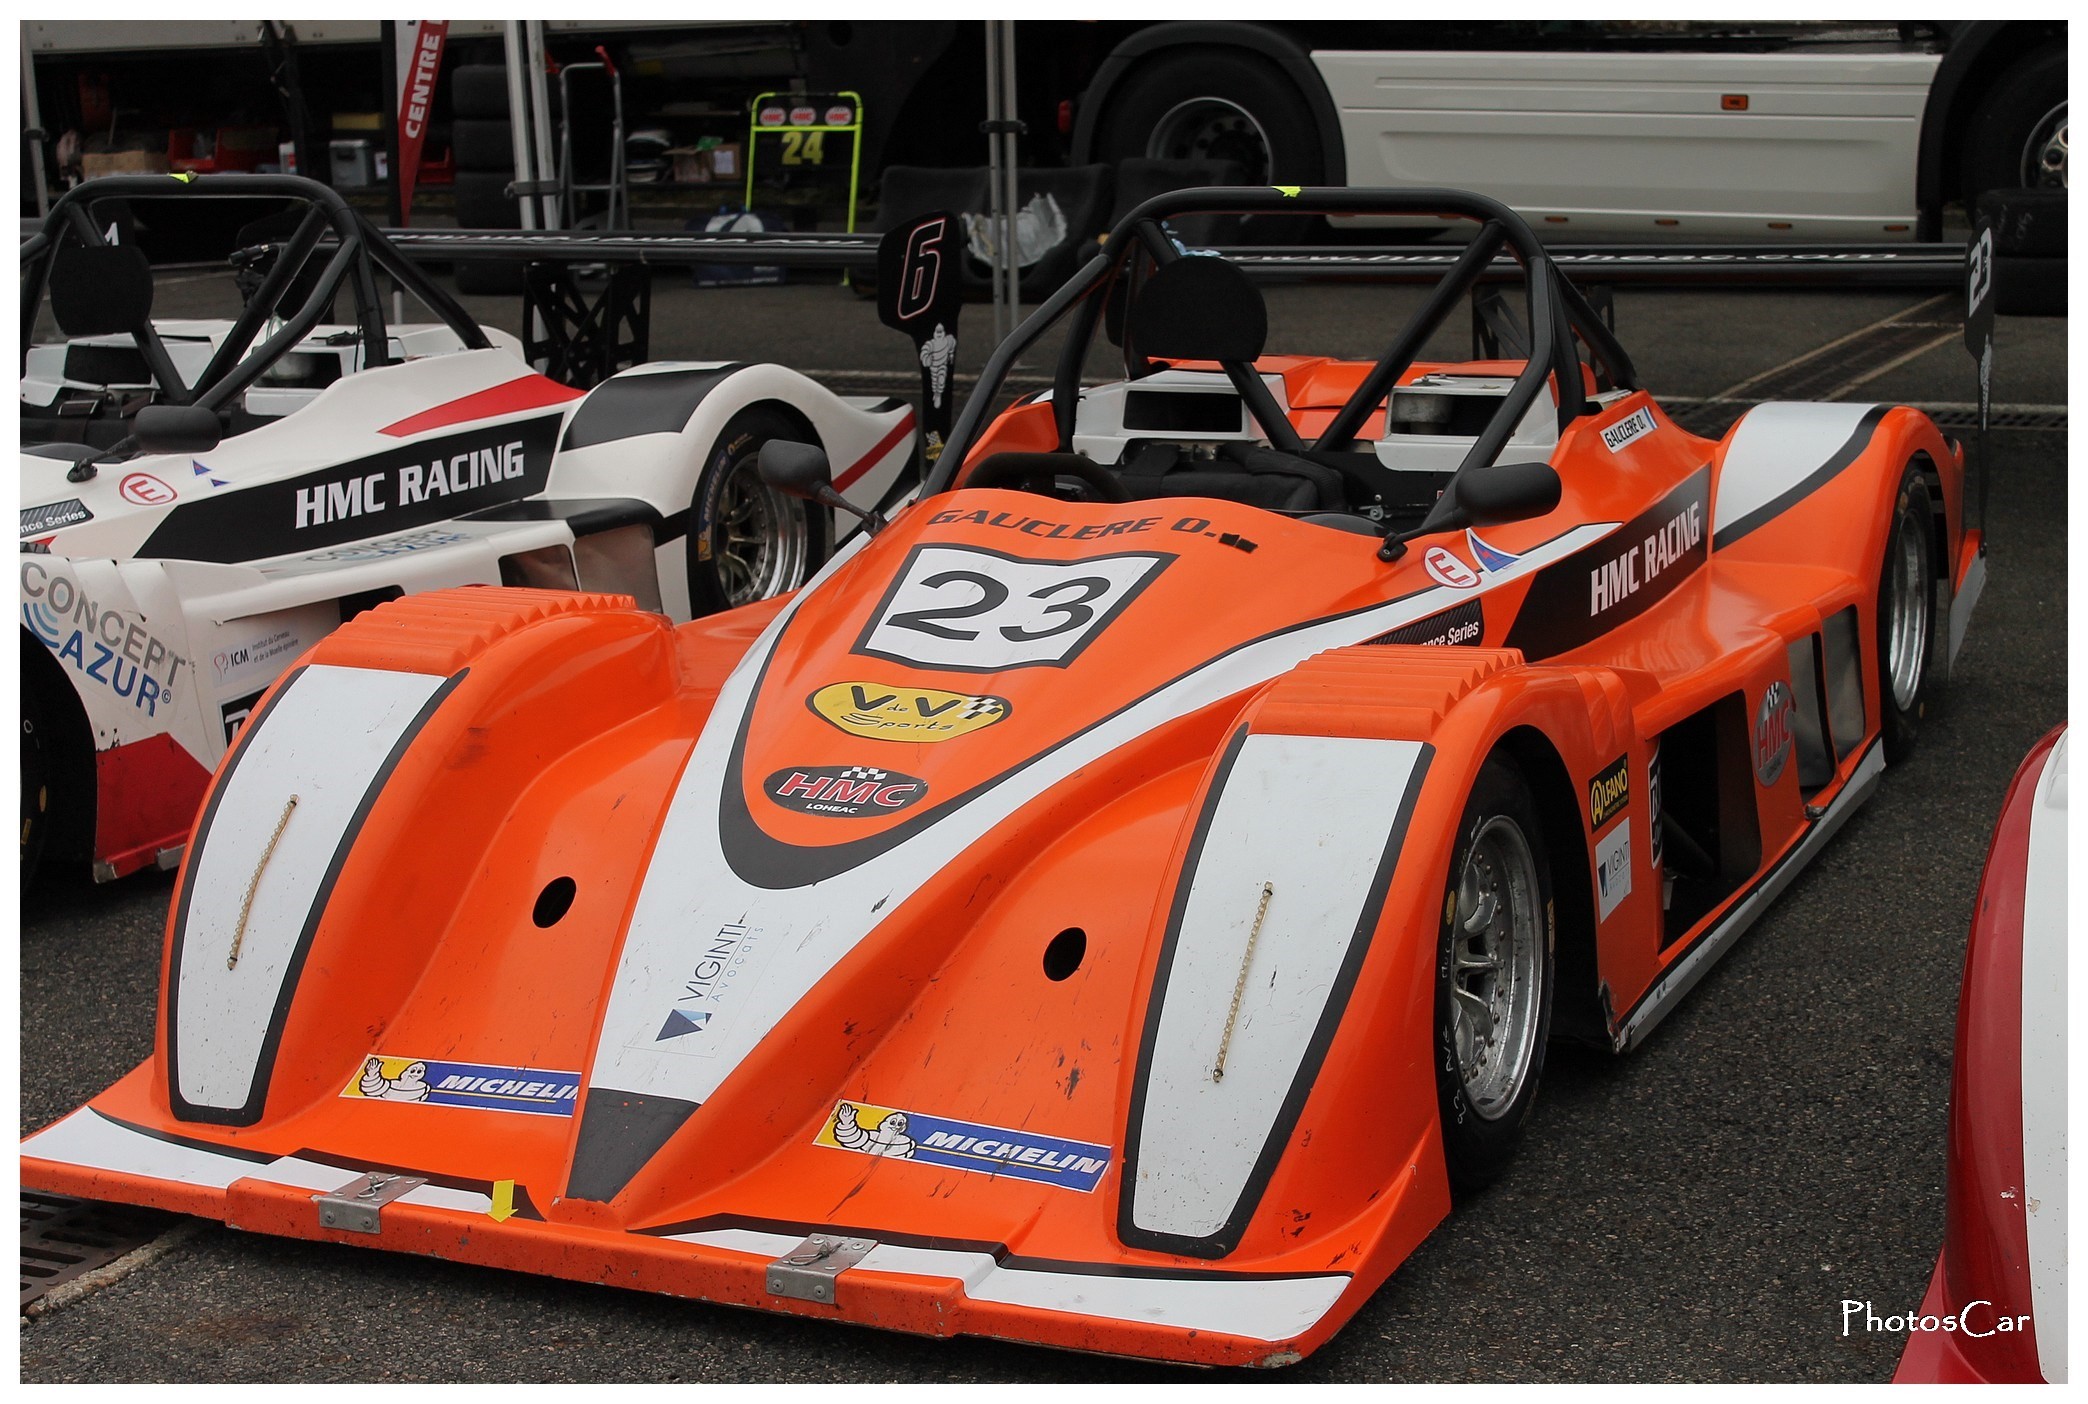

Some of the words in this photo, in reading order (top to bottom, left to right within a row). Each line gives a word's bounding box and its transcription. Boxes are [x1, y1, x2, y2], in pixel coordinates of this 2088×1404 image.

[405, 33, 441, 139] CENTRE
[782, 131, 823, 165] 24
[898, 218, 946, 320] 6
[1969, 227, 1992, 318] 23
[1604, 418, 1640, 448] GAUCLERE
[128, 479, 168, 503] E
[296, 472, 386, 530] HMC
[398, 440, 525, 507] RACING
[45, 509, 87, 526] Series
[926, 509, 1164, 540] GAUCLERE
[1428, 552, 1470, 585] E
[1590, 545, 1640, 617] HMC
[1644, 500, 1700, 584] RACING
[21, 561, 186, 688] CONCEPT
[887, 570, 1112, 643] 23
[1447, 621, 1479, 646] Series
[230, 648, 250, 668] ICM
[851, 685, 897, 711] V
[886, 703, 909, 712] de
[914, 696, 962, 717] V
[840, 712, 955, 731] Sports
[1757, 698, 1791, 771] HMC
[774, 771, 918, 807] HMC
[805, 802, 858, 814] LOHEAC
[1590, 767, 1628, 826] ALFANO
[677, 923, 747, 1002] VIGINTI
[711, 927, 764, 1002] Avocats
[923, 1131, 1106, 1174] MICHELIN
